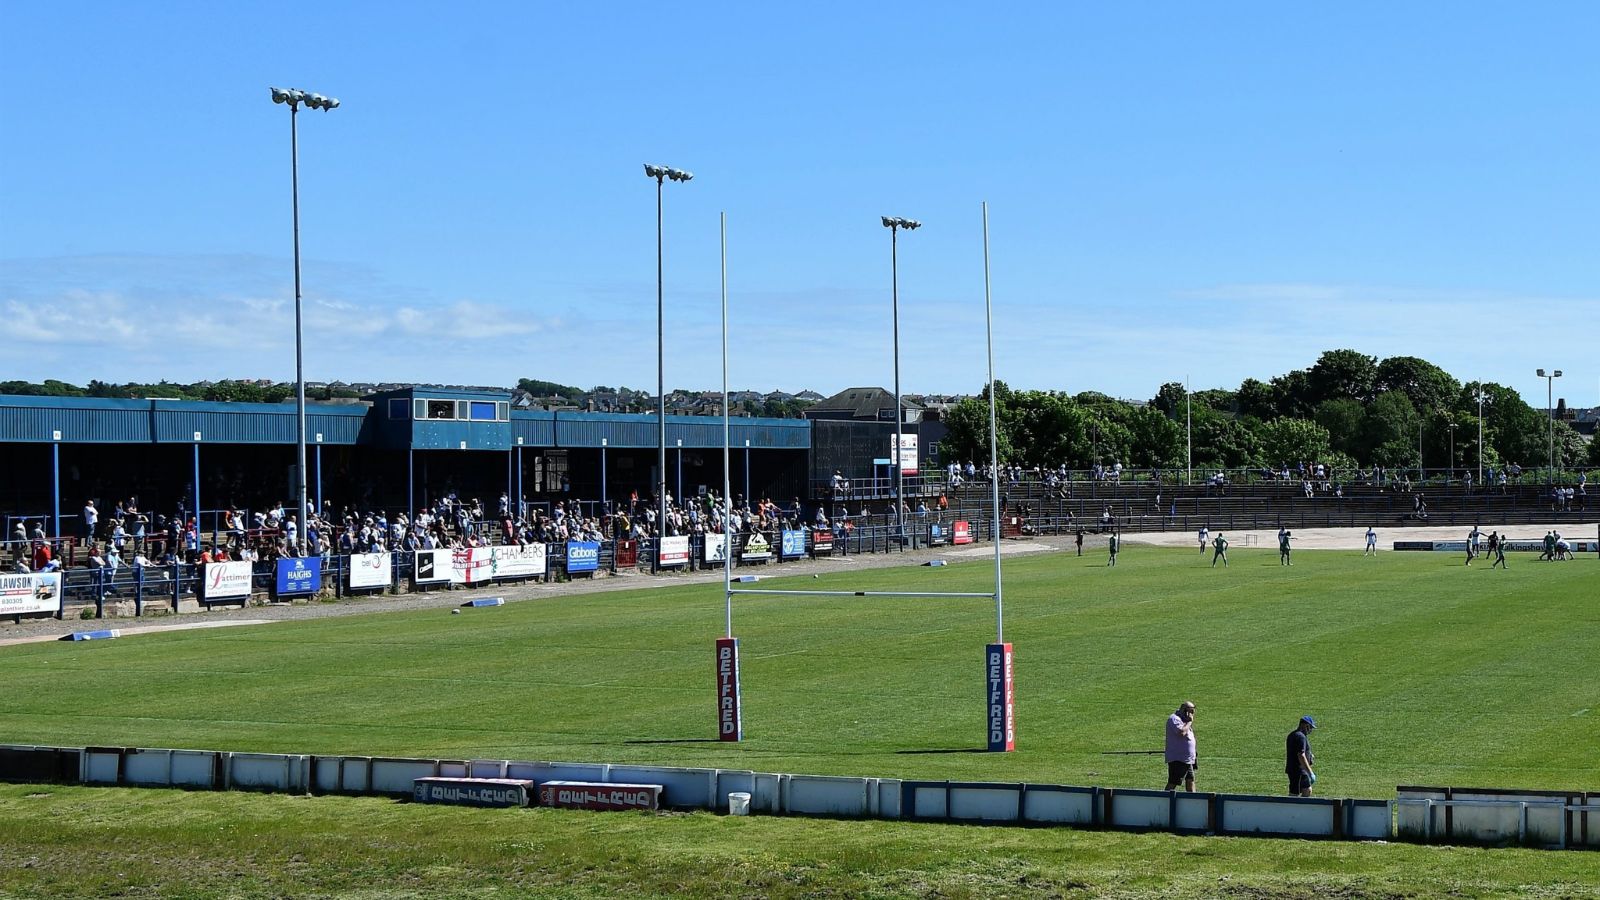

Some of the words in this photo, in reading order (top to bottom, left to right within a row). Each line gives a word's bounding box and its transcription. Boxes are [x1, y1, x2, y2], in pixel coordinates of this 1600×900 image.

[496, 545, 543, 560] CHAMBERS
[570, 547, 597, 558] Gibbons
[1503, 543, 1546, 552] alkingshaw
[0, 576, 32, 590] LAWSON
[207, 564, 250, 590] Lattimer
[287, 570, 312, 580] HAIGHS
[720, 647, 734, 734] BETFRED
[990, 652, 1003, 743] BETFRED
[1005, 652, 1013, 743] BETFRED
[431, 786, 519, 803] BETFRED
[559, 790, 649, 806] BETFRED
